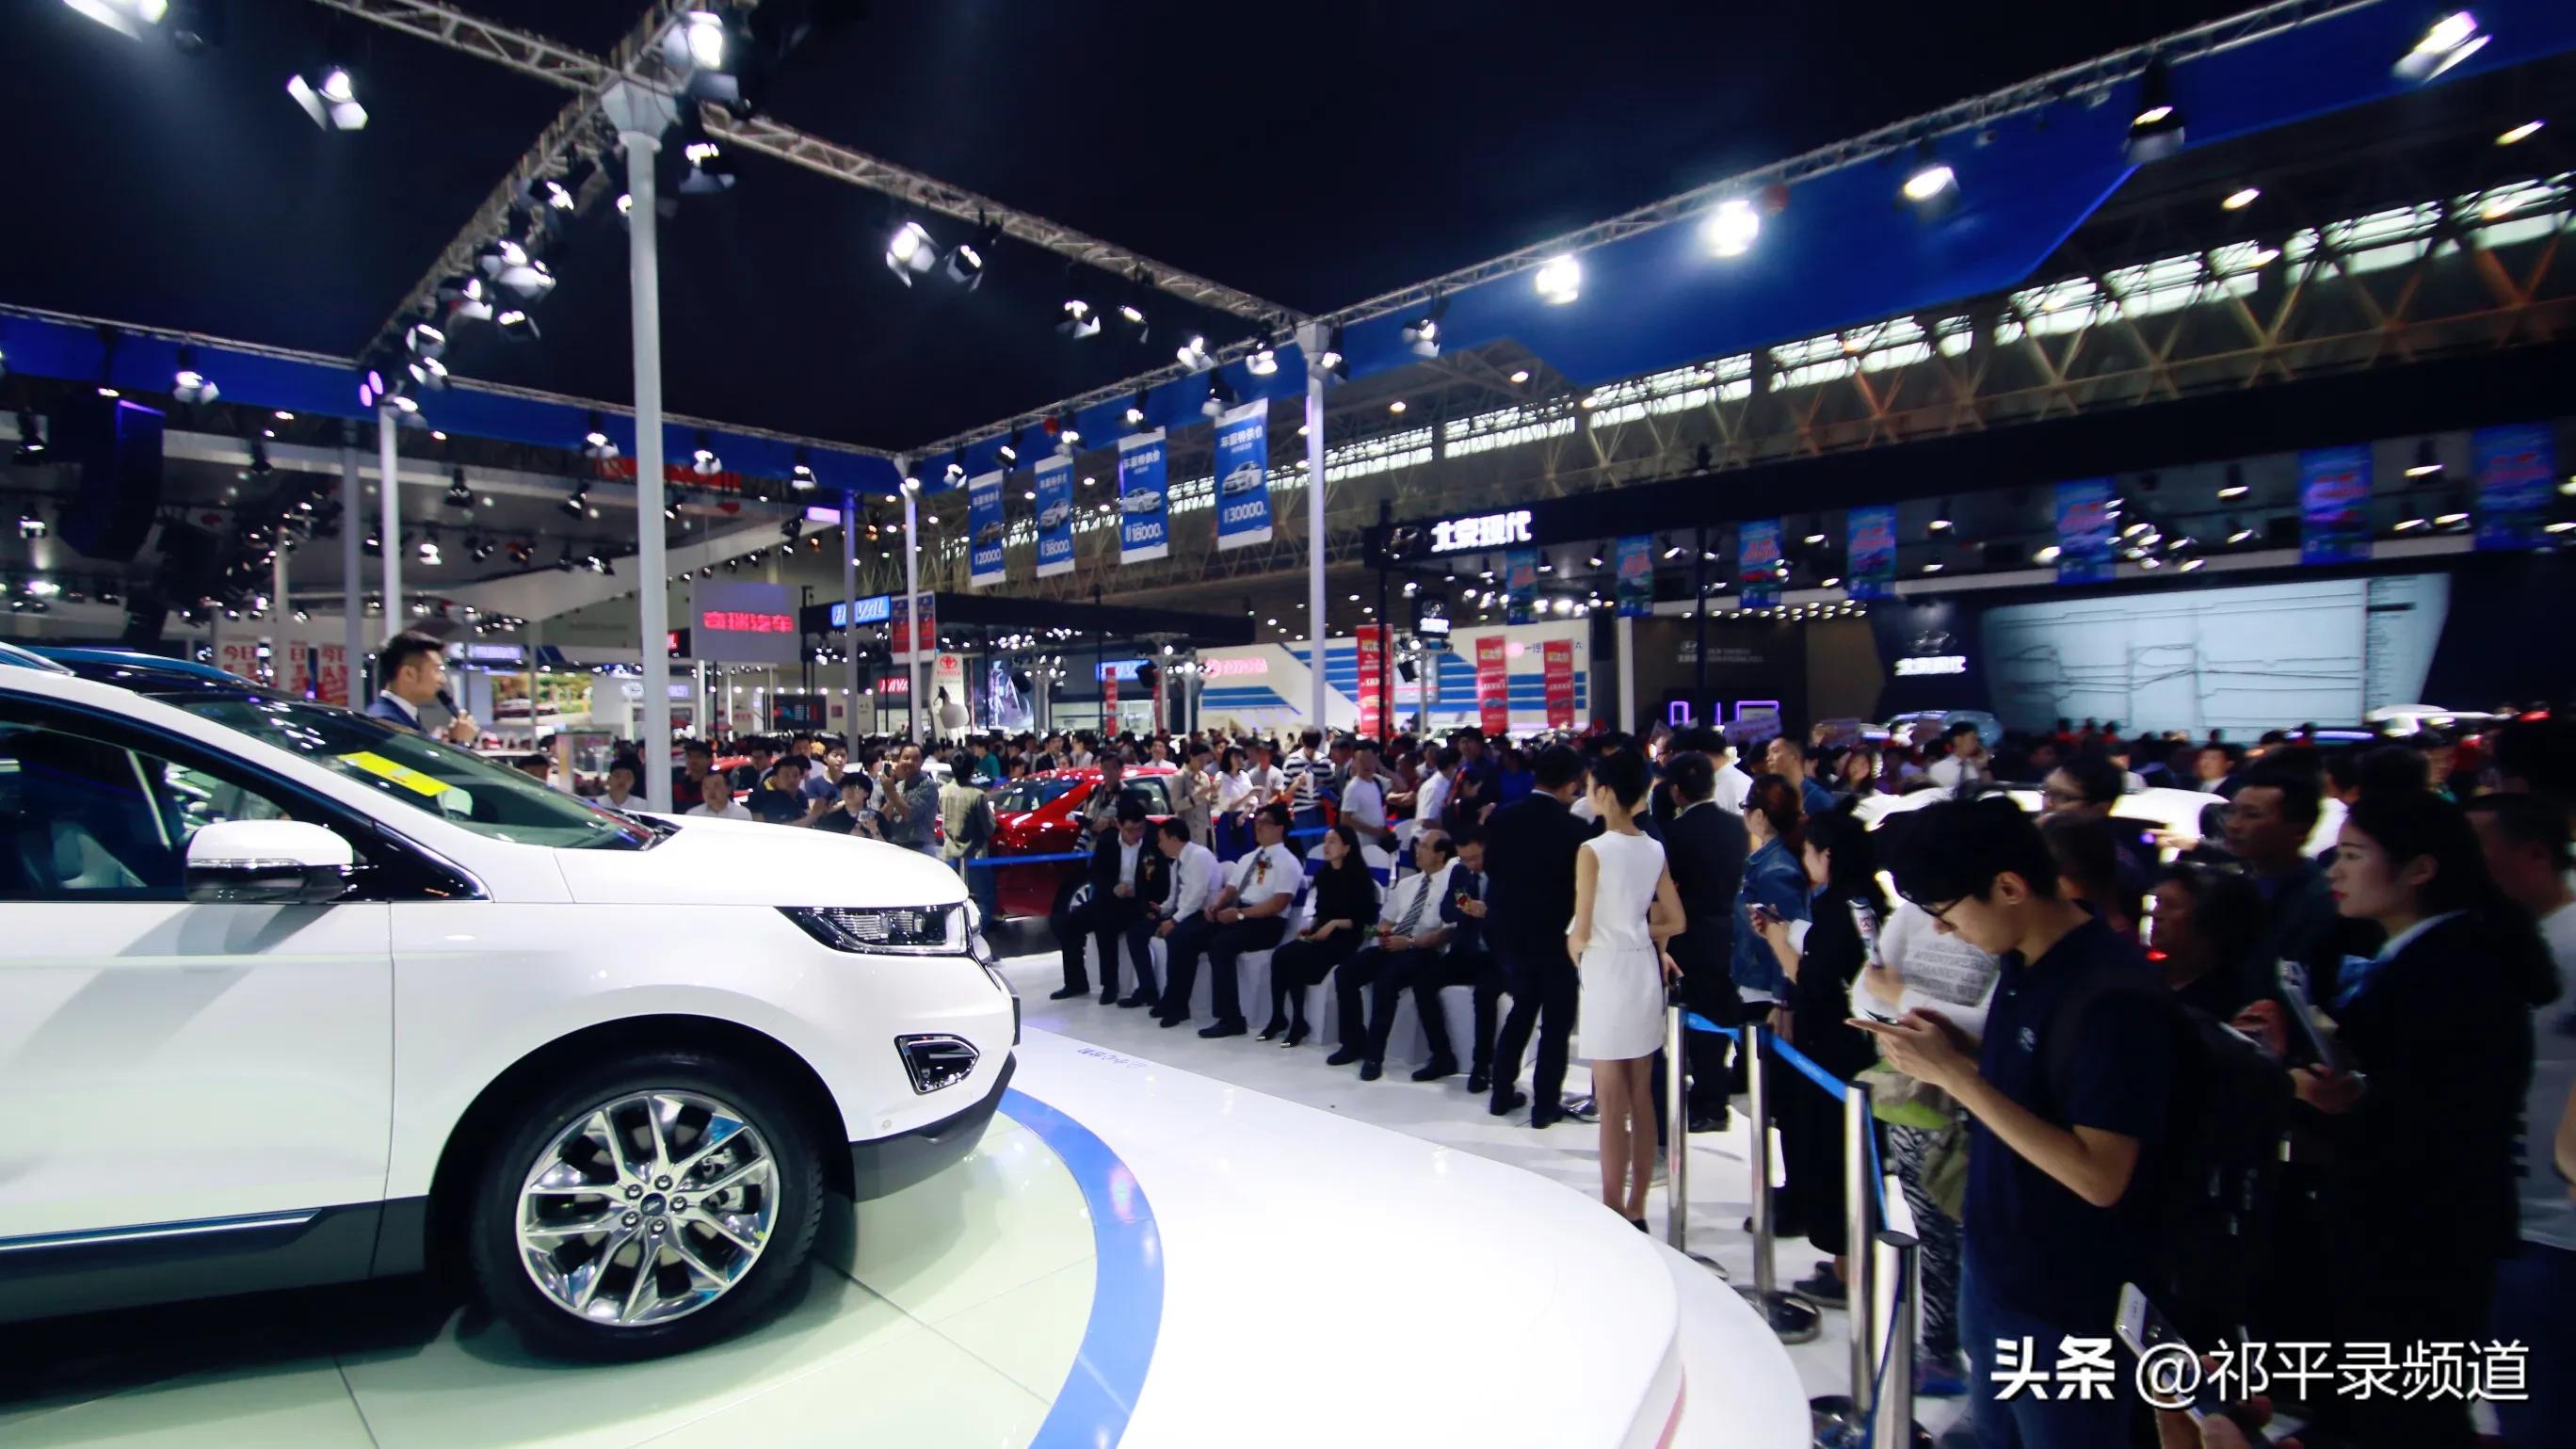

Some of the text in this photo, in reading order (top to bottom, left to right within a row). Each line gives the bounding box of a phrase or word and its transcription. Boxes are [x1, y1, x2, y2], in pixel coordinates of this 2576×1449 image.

[1430, 510, 1533, 553] 北京现代
[834, 597, 884, 623] HVAL
